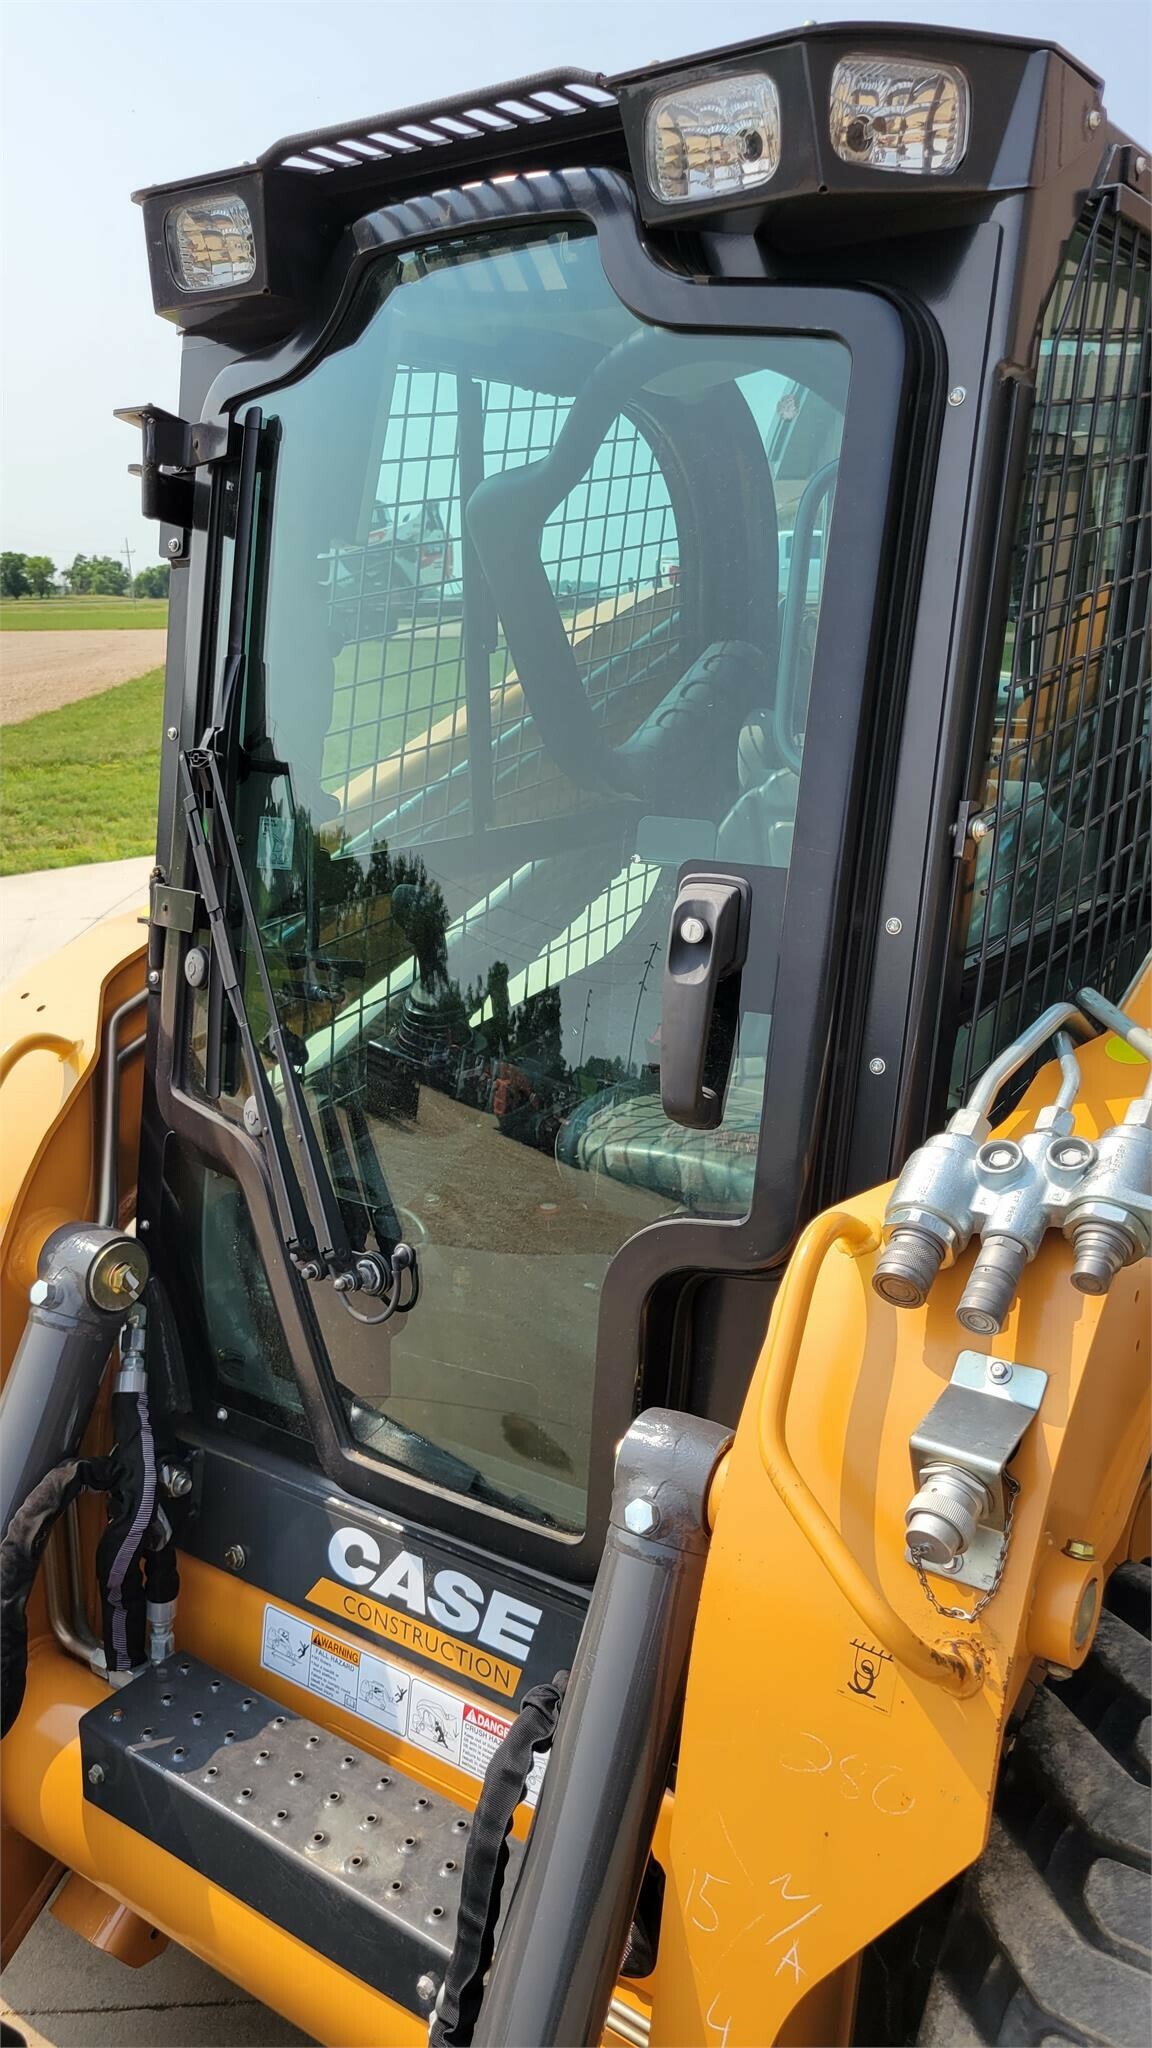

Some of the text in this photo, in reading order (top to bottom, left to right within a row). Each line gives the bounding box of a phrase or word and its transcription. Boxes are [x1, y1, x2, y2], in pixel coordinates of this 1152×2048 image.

[328, 1527, 543, 1662] CASE
[320, 1637, 358, 1663] WARNING
[343, 1595, 511, 1689] CONSTRUCTION
[315, 1649, 355, 1672] FALL HAZARD
[465, 1722, 488, 1739] CRUSH
[477, 1714, 511, 1739] DANGE
